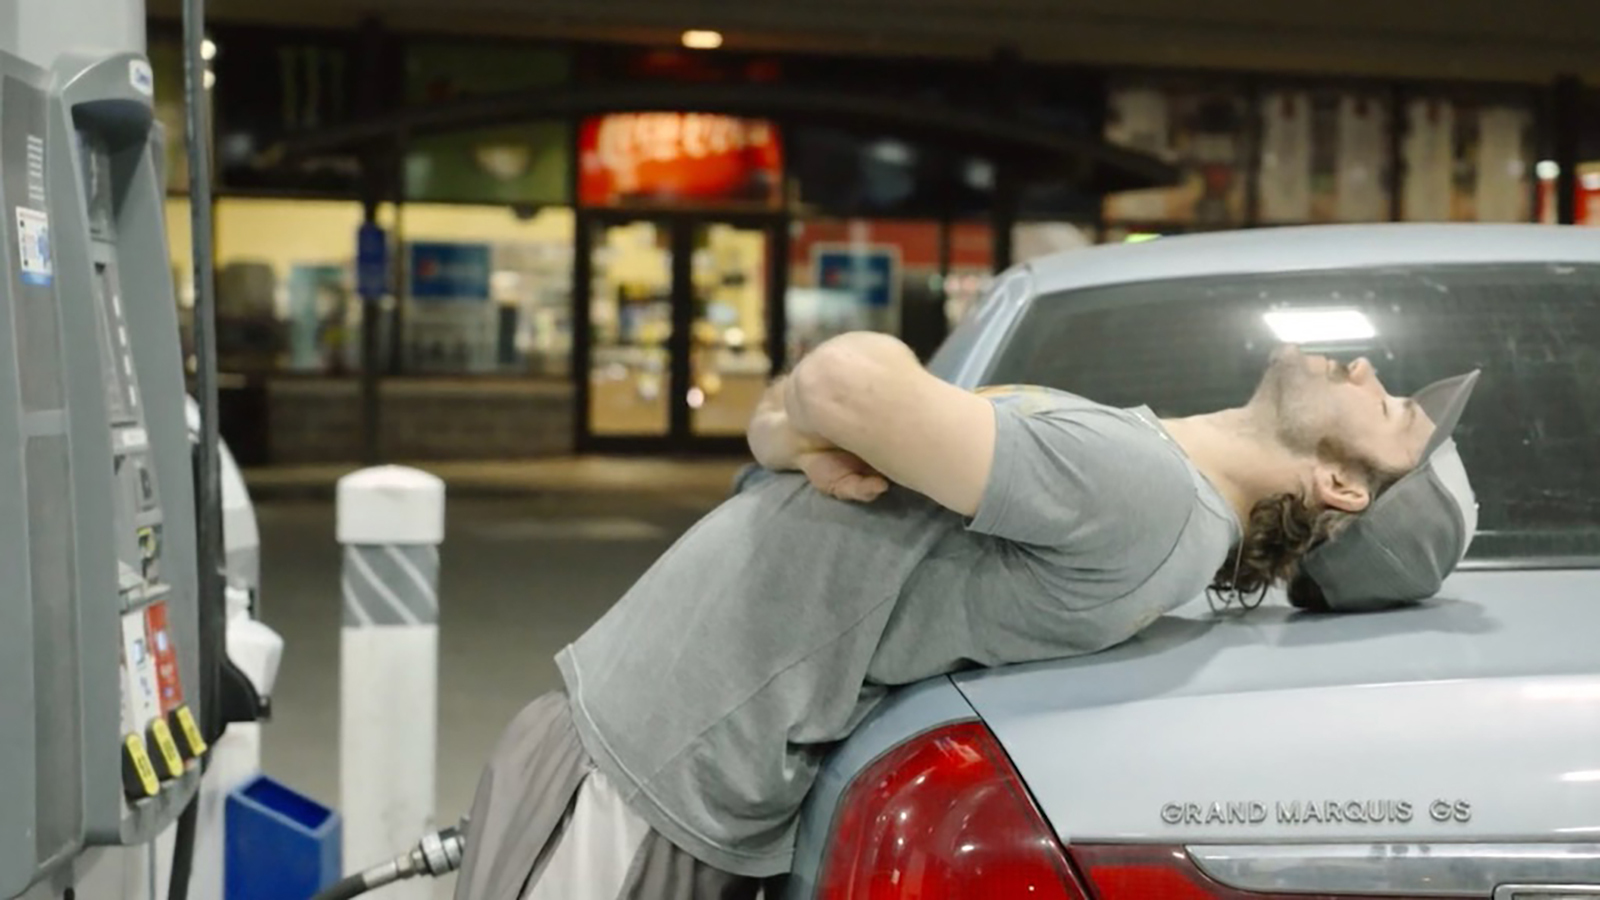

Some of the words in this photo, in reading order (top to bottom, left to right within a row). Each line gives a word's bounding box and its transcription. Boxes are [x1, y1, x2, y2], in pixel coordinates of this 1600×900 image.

[1160, 801, 1268, 825] GRAND
[1276, 800, 1413, 824] MARQUIS
[1429, 799, 1472, 823] GS
